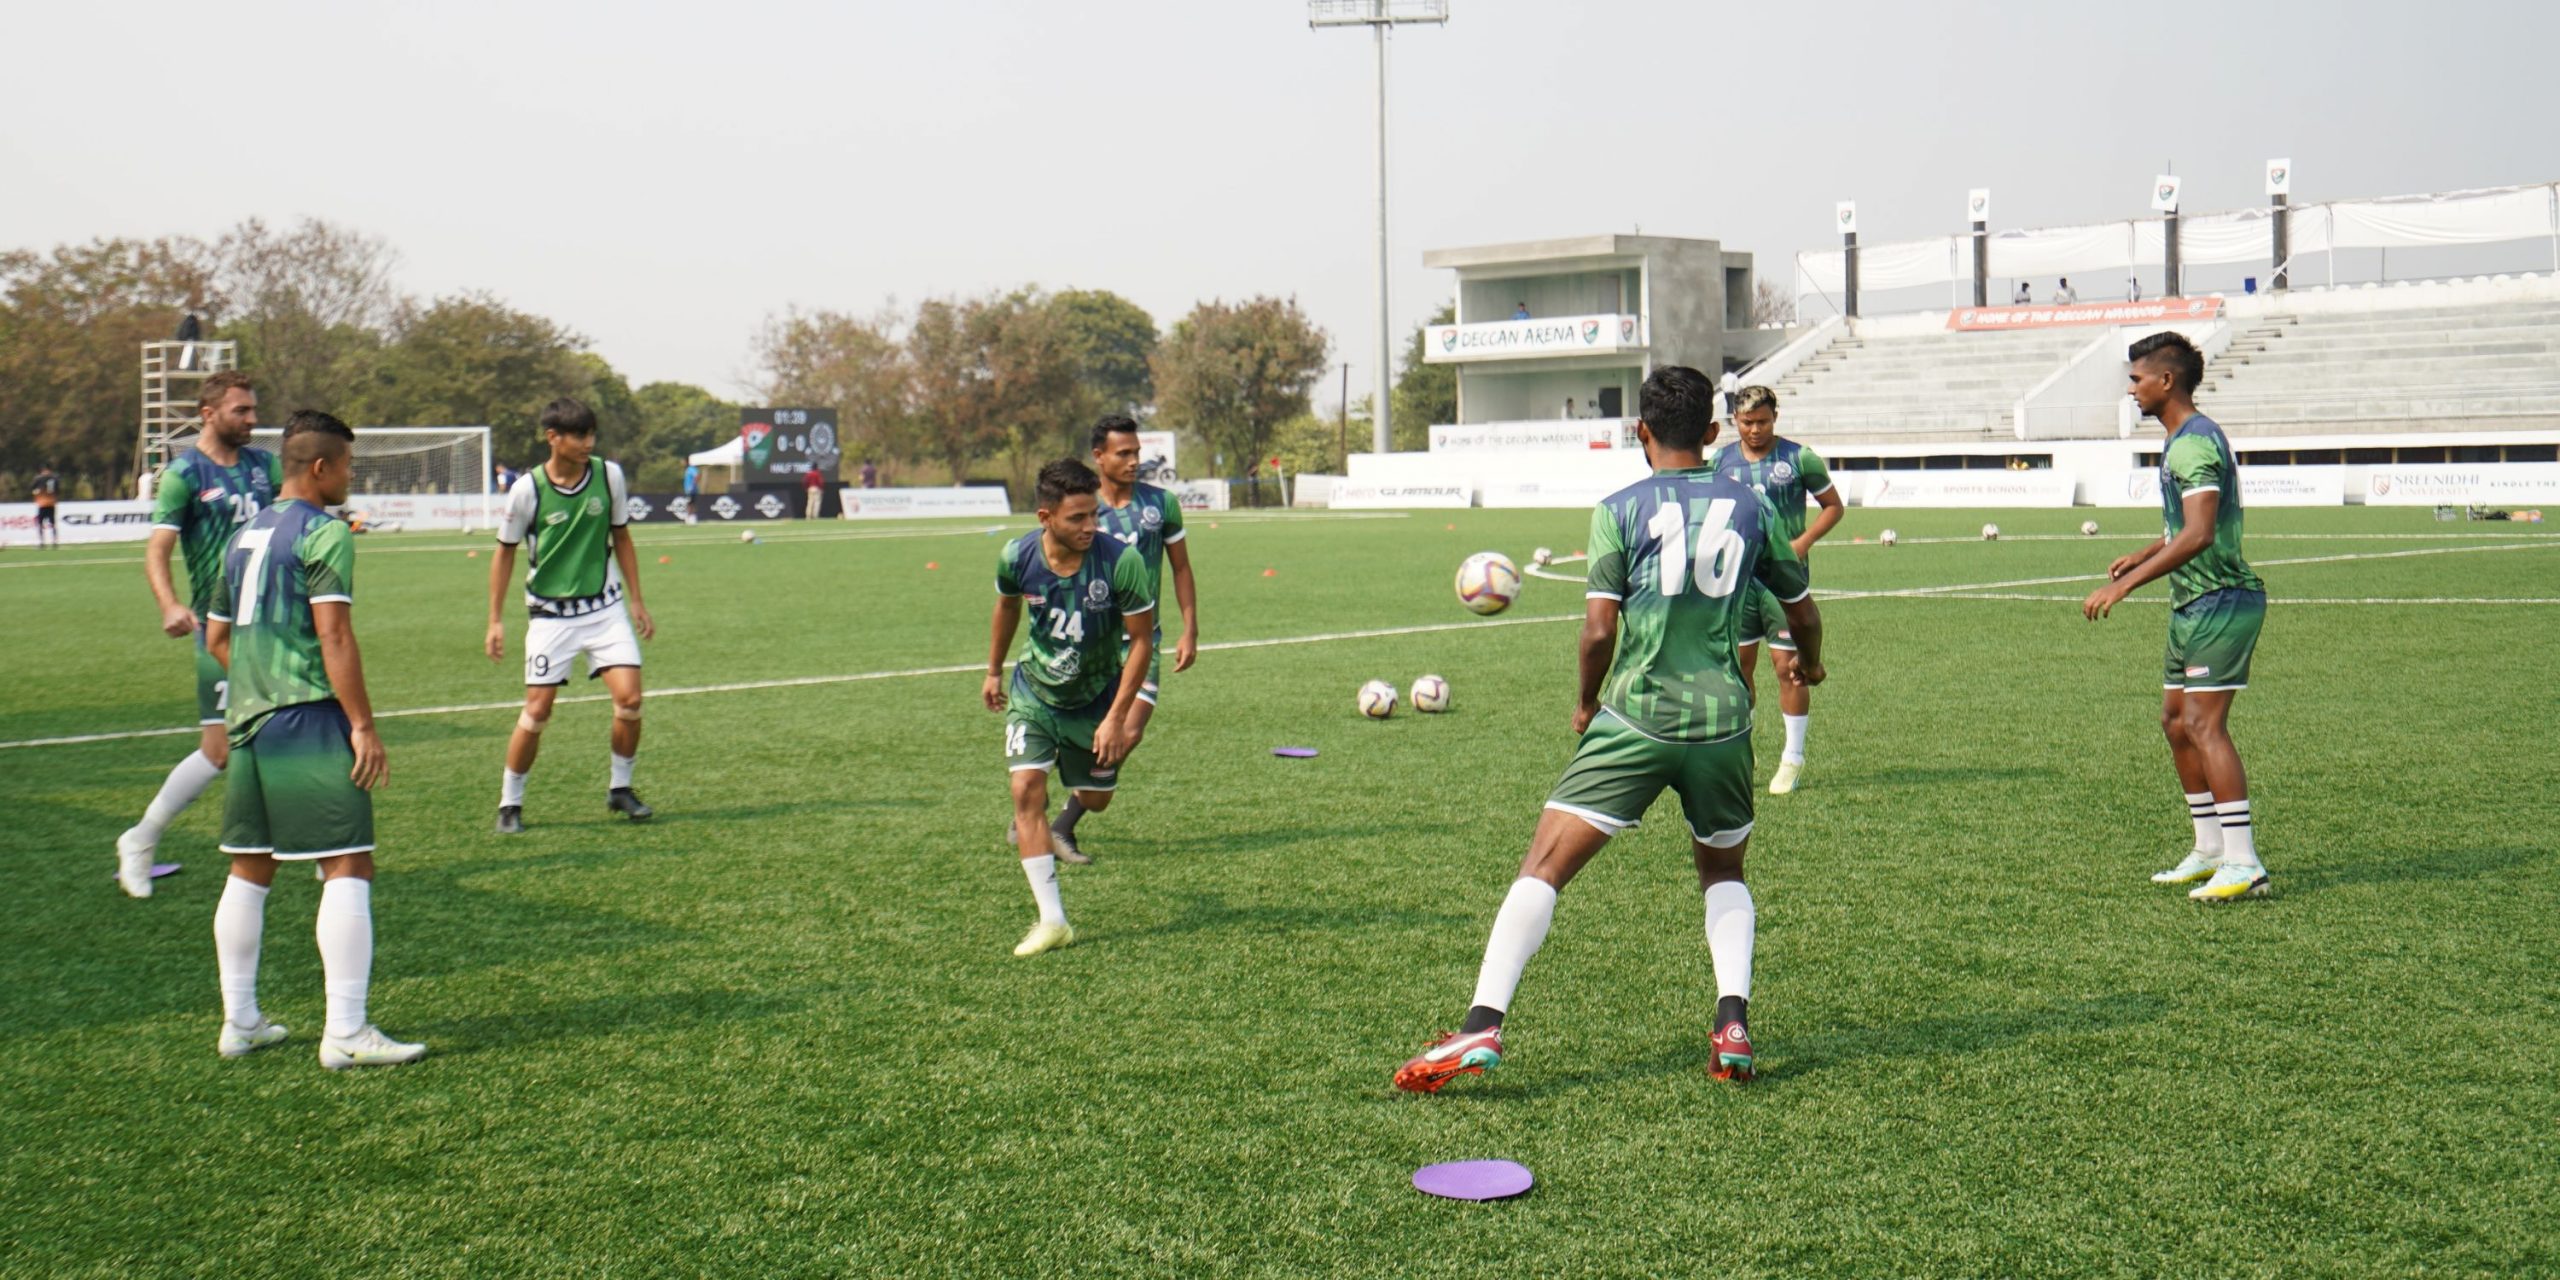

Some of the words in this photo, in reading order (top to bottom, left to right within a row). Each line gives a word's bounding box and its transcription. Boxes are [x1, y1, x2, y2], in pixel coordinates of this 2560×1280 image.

[1462, 329, 1519, 347] DECCAN
[1524, 325, 1575, 345] ARENA
[777, 435, 788, 452] 0
[795, 435, 806, 452] 0
[2395, 474, 2479, 485] SREENIDHI
[229, 492, 260, 523] 26
[1648, 498, 1745, 598] 16
[236, 527, 276, 626] 7
[1050, 608, 1084, 643] 24
[528, 654, 549, 677] 19
